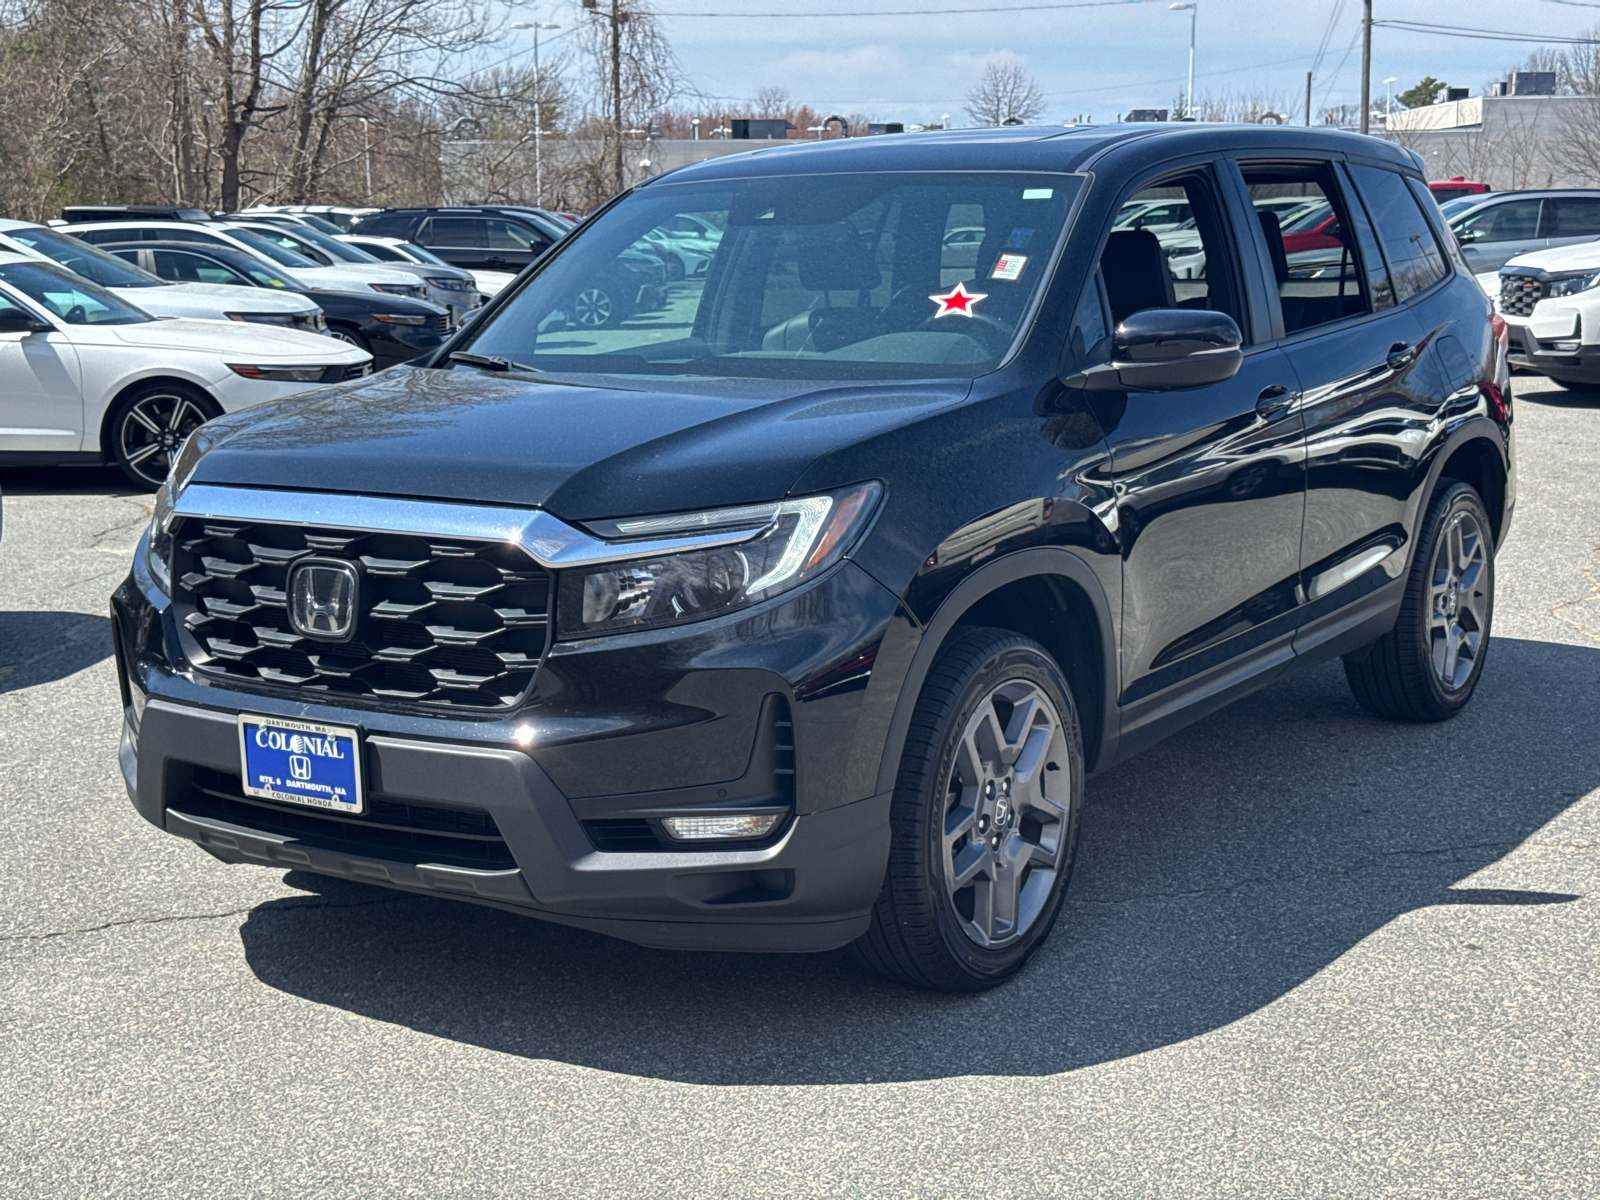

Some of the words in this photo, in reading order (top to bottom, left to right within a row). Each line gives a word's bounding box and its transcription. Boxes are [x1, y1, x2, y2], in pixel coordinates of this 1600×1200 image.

[255, 727, 345, 759] COLONIAL
[259, 775, 275, 784] RTE.
[276, 777, 282, 785] 6
[286, 779, 334, 794] DARTMOUTH,
[335, 786, 347, 795] MA
[271, 792, 306, 804] COLONIAL
[307, 798, 333, 808] HONDA
